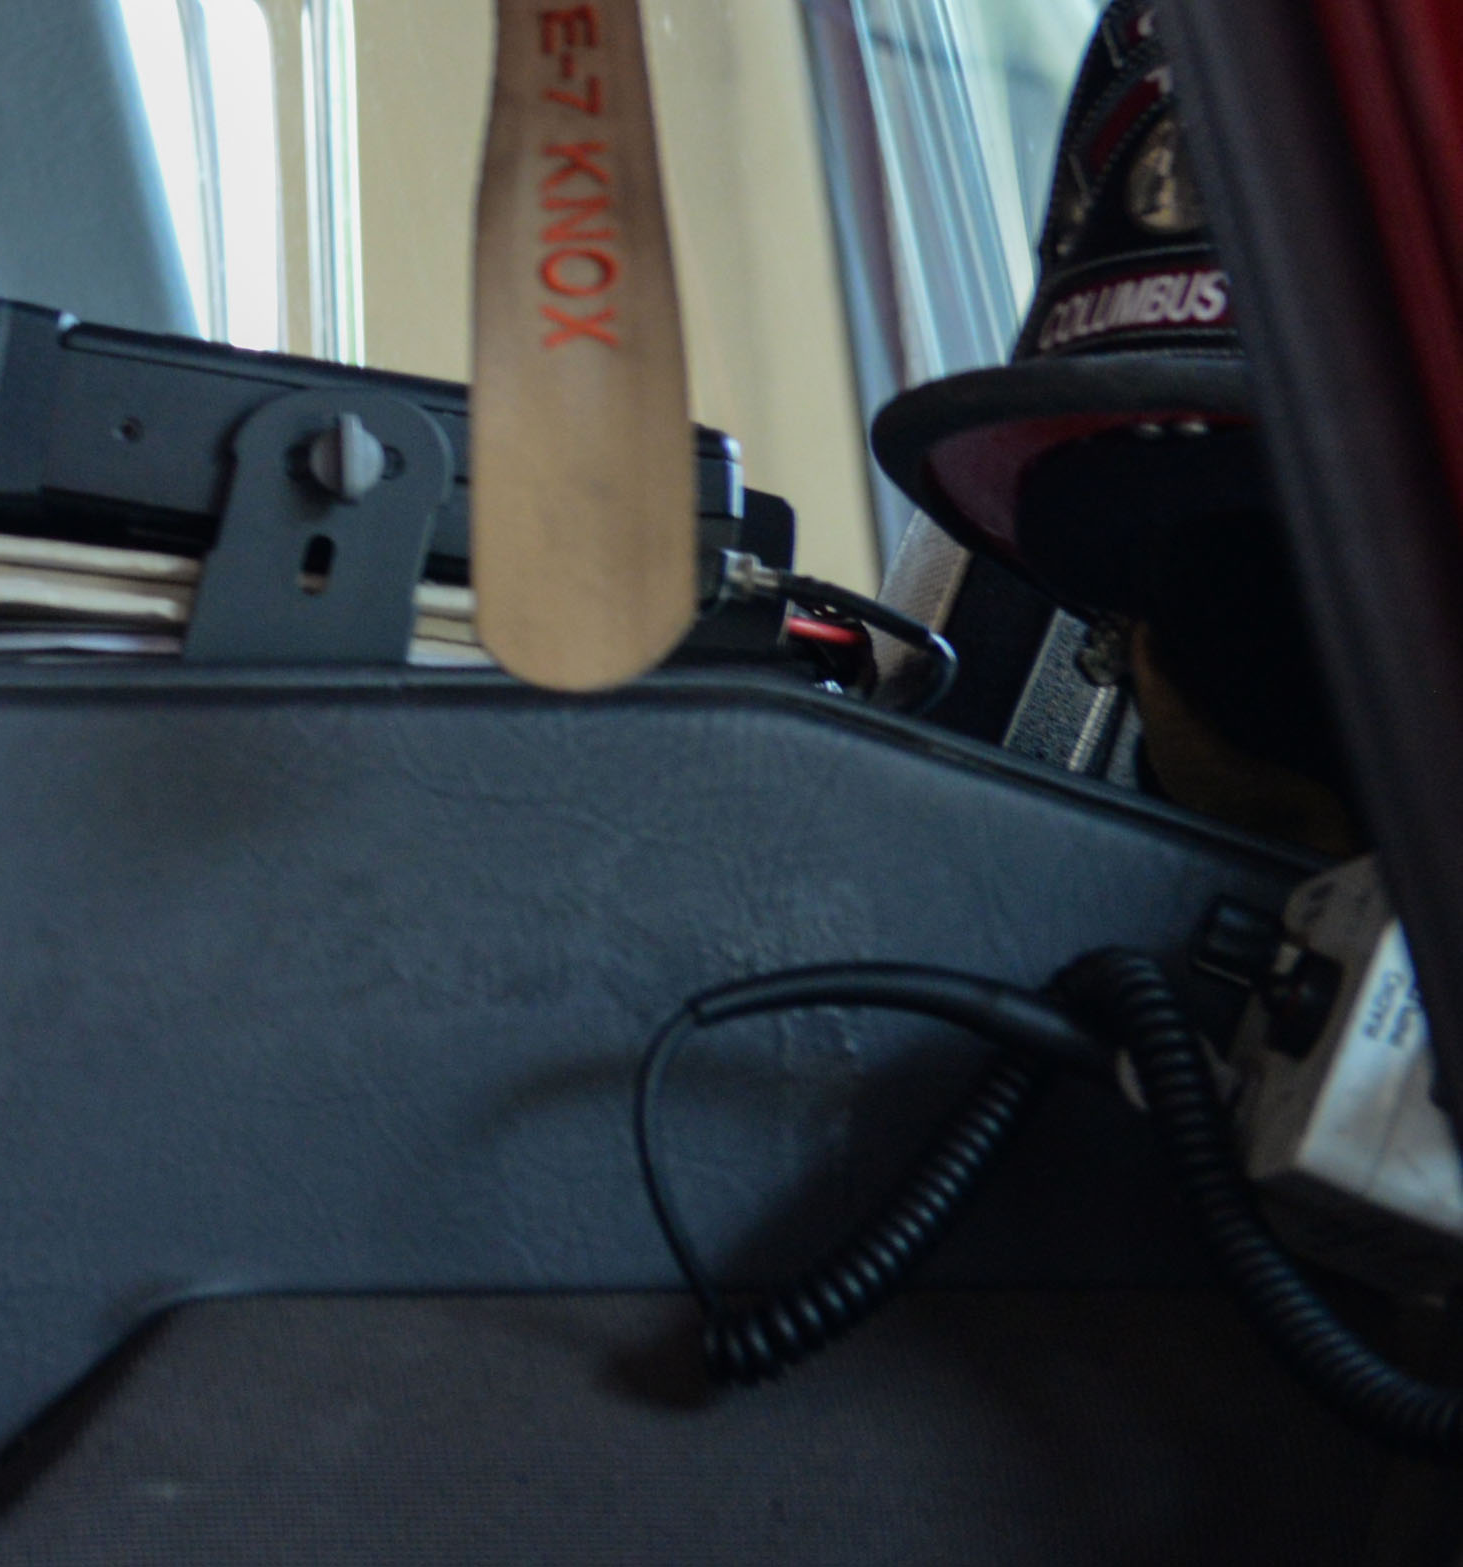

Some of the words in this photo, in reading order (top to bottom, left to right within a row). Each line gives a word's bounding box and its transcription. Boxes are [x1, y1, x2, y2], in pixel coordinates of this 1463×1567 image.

[539, 5, 602, 115] E-7
[539, 141, 619, 350] KNOX
[1038, 269, 1232, 351] COLUMBUS
